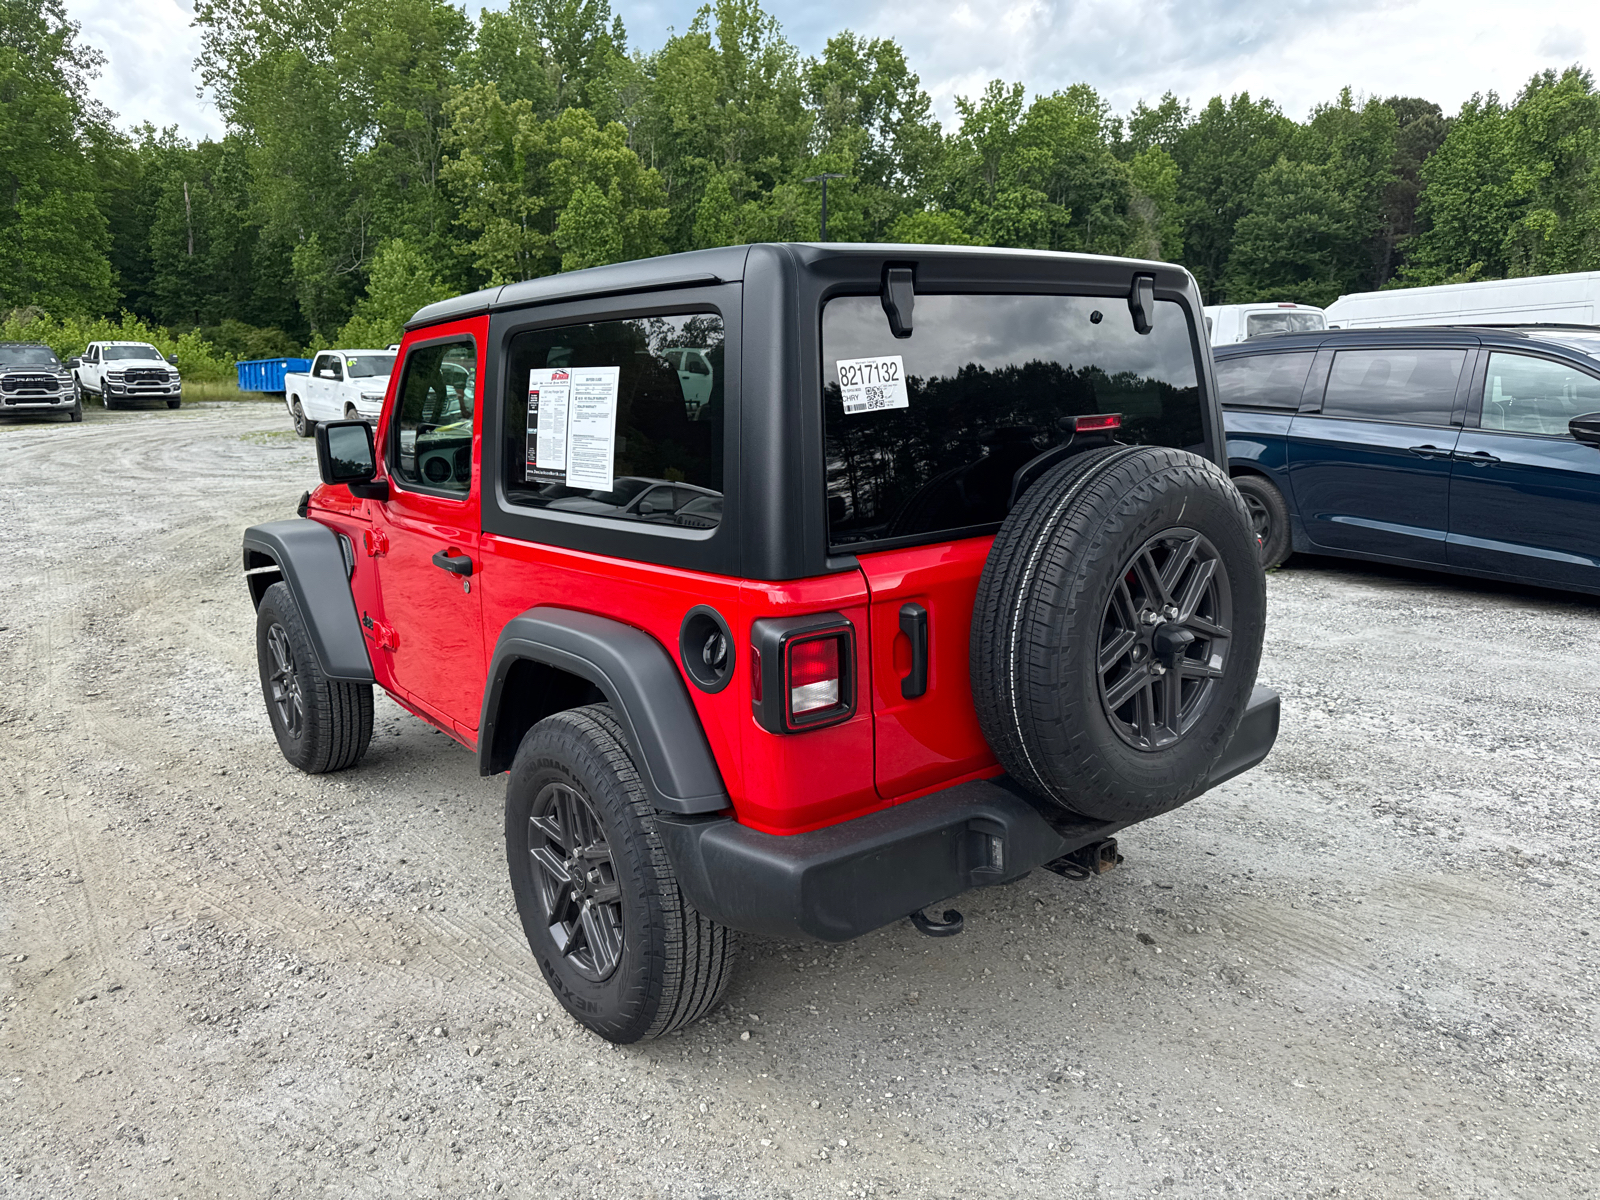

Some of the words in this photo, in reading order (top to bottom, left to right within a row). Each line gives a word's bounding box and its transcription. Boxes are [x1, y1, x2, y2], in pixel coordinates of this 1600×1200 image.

[840, 362, 899, 387] 8217132
[842, 394, 860, 403] CHRY
[543, 958, 598, 1013] NEXEN
